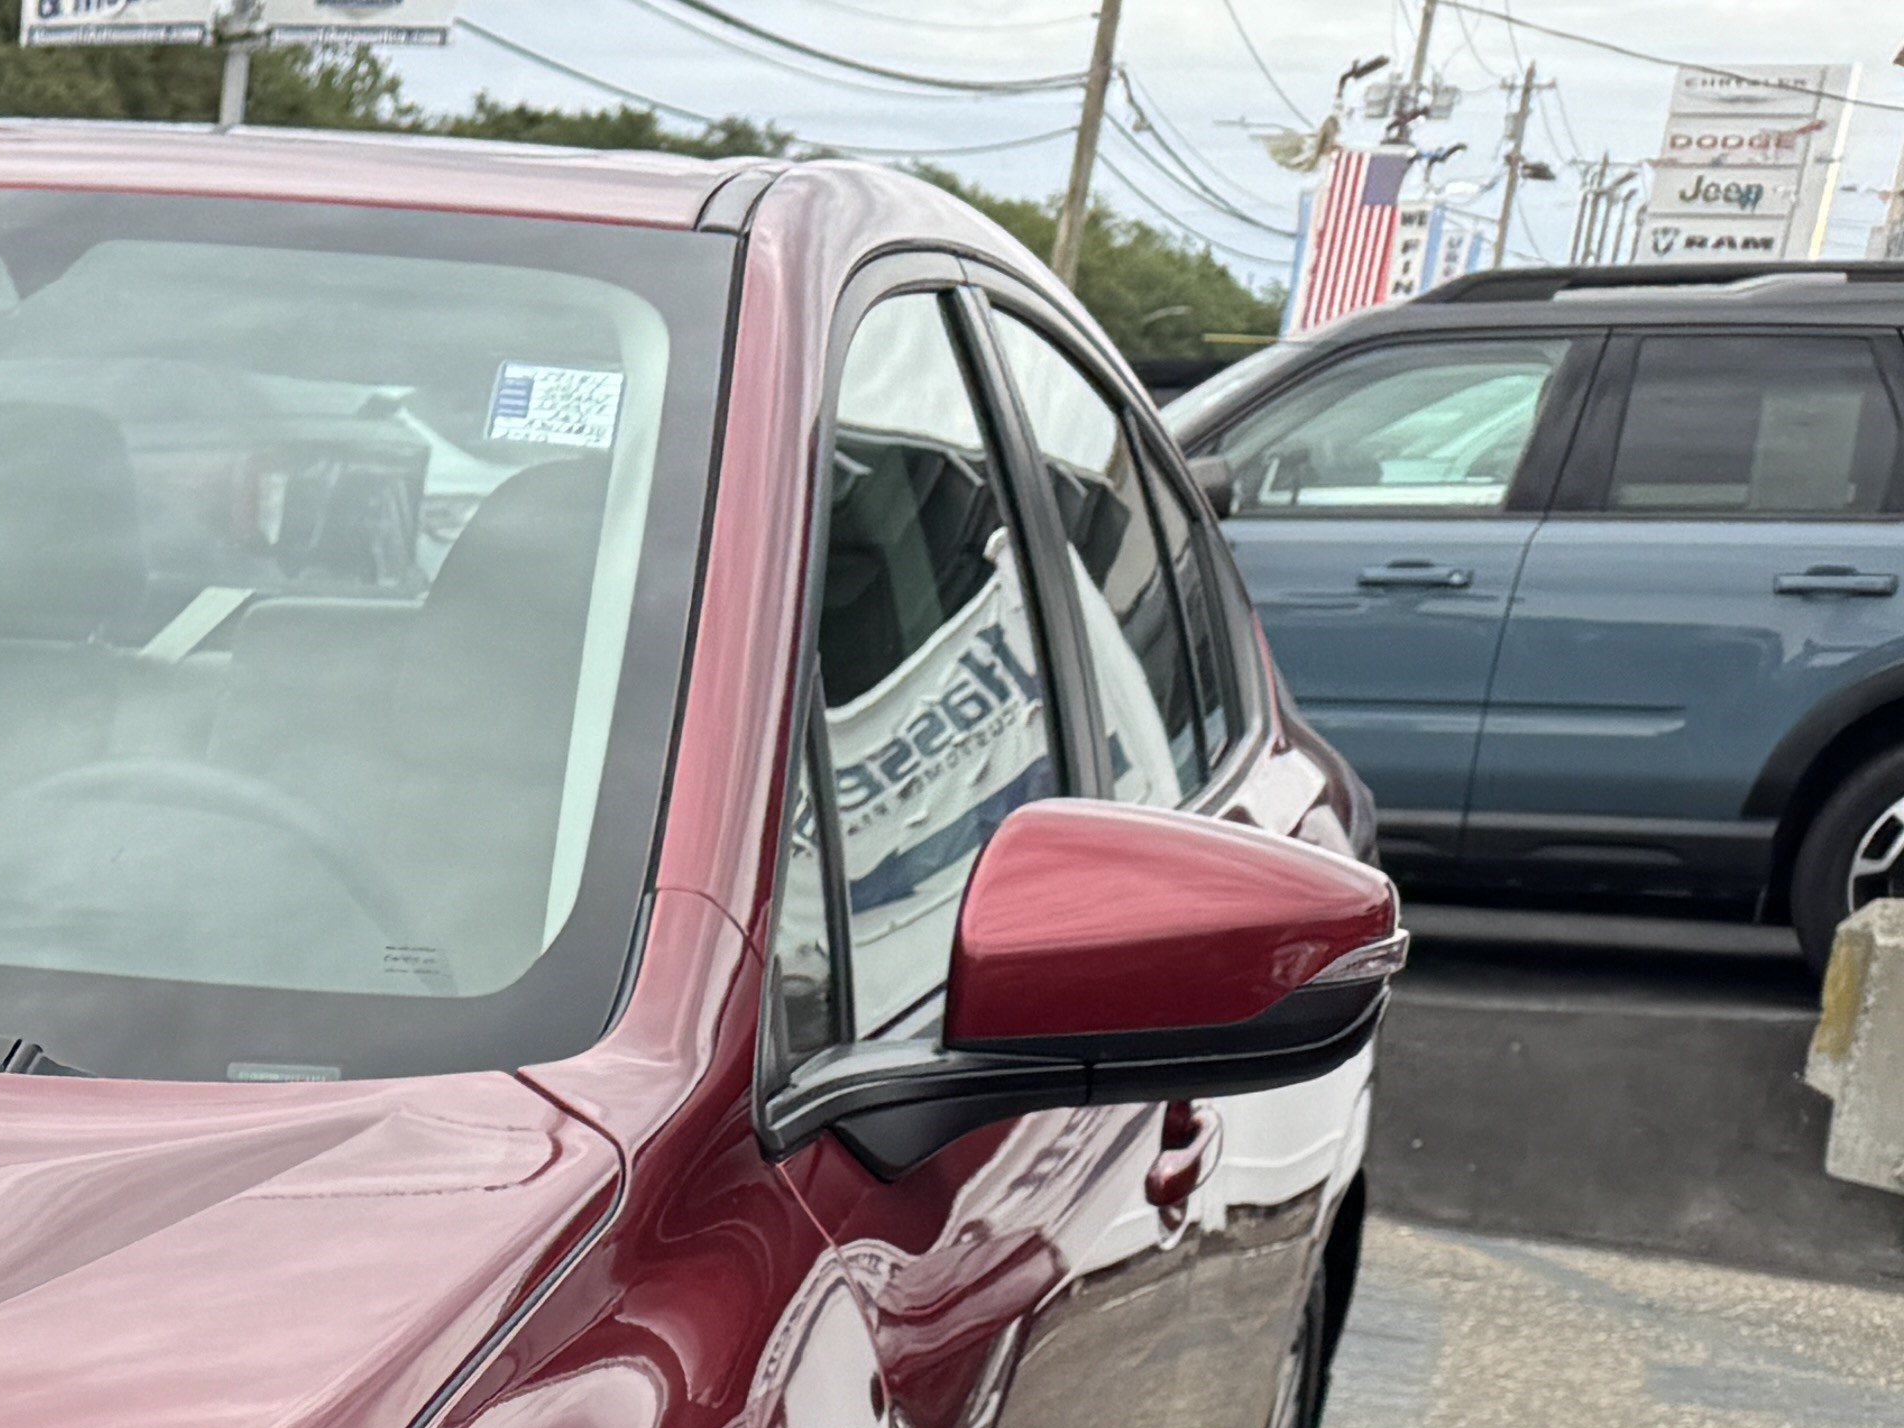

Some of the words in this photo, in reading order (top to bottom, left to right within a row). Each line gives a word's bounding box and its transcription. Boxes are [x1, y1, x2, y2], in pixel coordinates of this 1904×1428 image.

[1669, 133, 1798, 150] DODGE
[1679, 175, 1765, 212] Jeep
[1684, 236, 1775, 251] RAM
